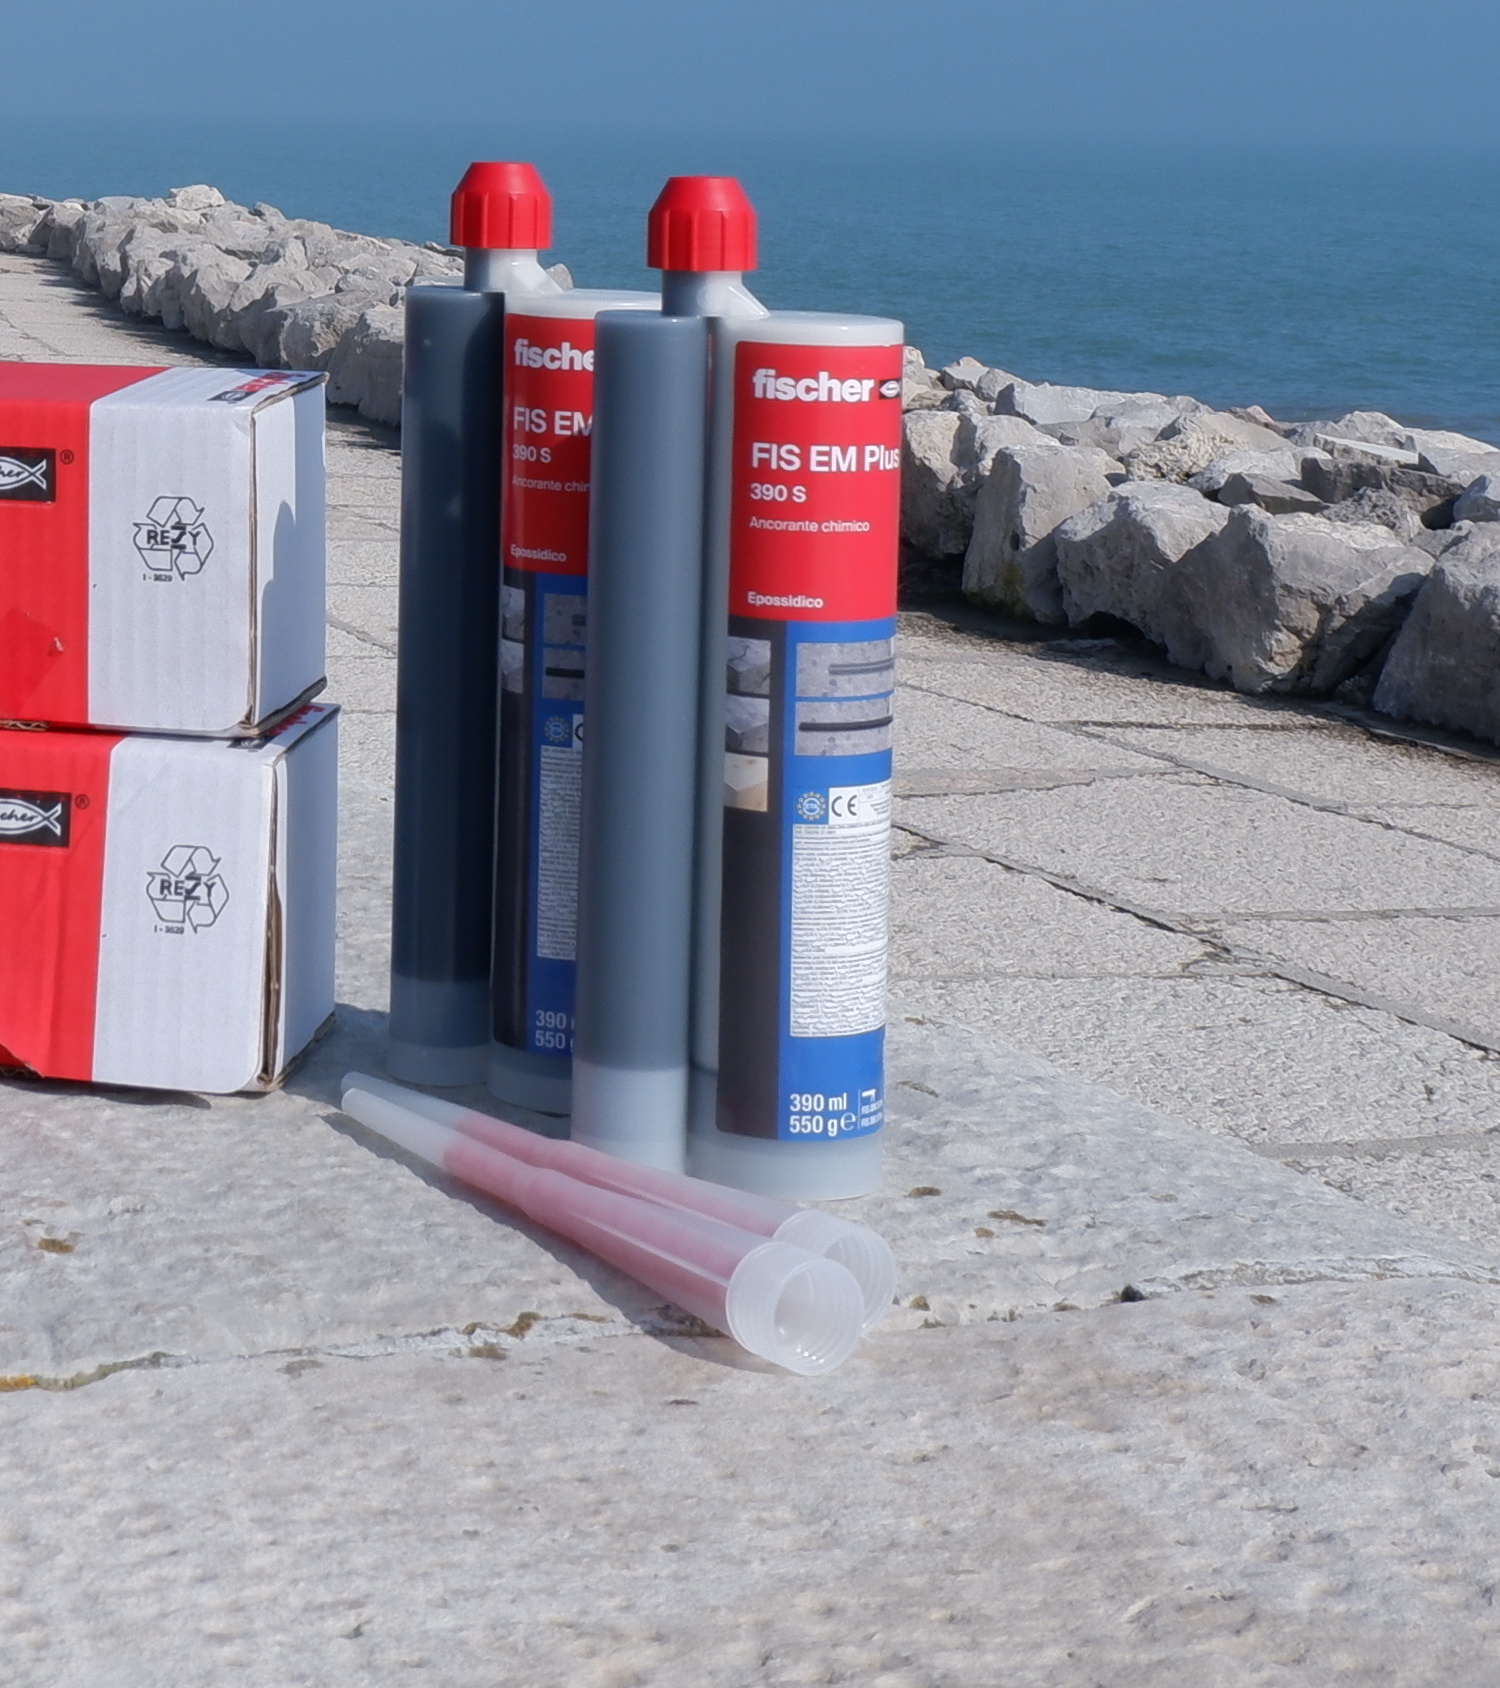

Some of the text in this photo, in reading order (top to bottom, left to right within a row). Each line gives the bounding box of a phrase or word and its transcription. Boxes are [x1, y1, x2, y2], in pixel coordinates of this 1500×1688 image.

[514, 338, 595, 372] fische
[753, 368, 874, 402] fischer
[513, 406, 593, 436] FIS EM
[512, 443, 552, 463] 390 S
[752, 442, 900, 472] FIS EM Plus
[512, 474, 562, 491] Ancorante
[750, 482, 807, 503] 390 S
[749, 516, 870, 532] Ancorante chimico
[510, 543, 567, 562] Epossidico
[747, 590, 824, 609] Epossidico
[535, 1009, 567, 1030] 390
[535, 1029, 566, 1049] 550
[790, 1092, 847, 1112] 390 ml
[789, 1115, 824, 1134] 550
[827, 1118, 838, 1137] g
